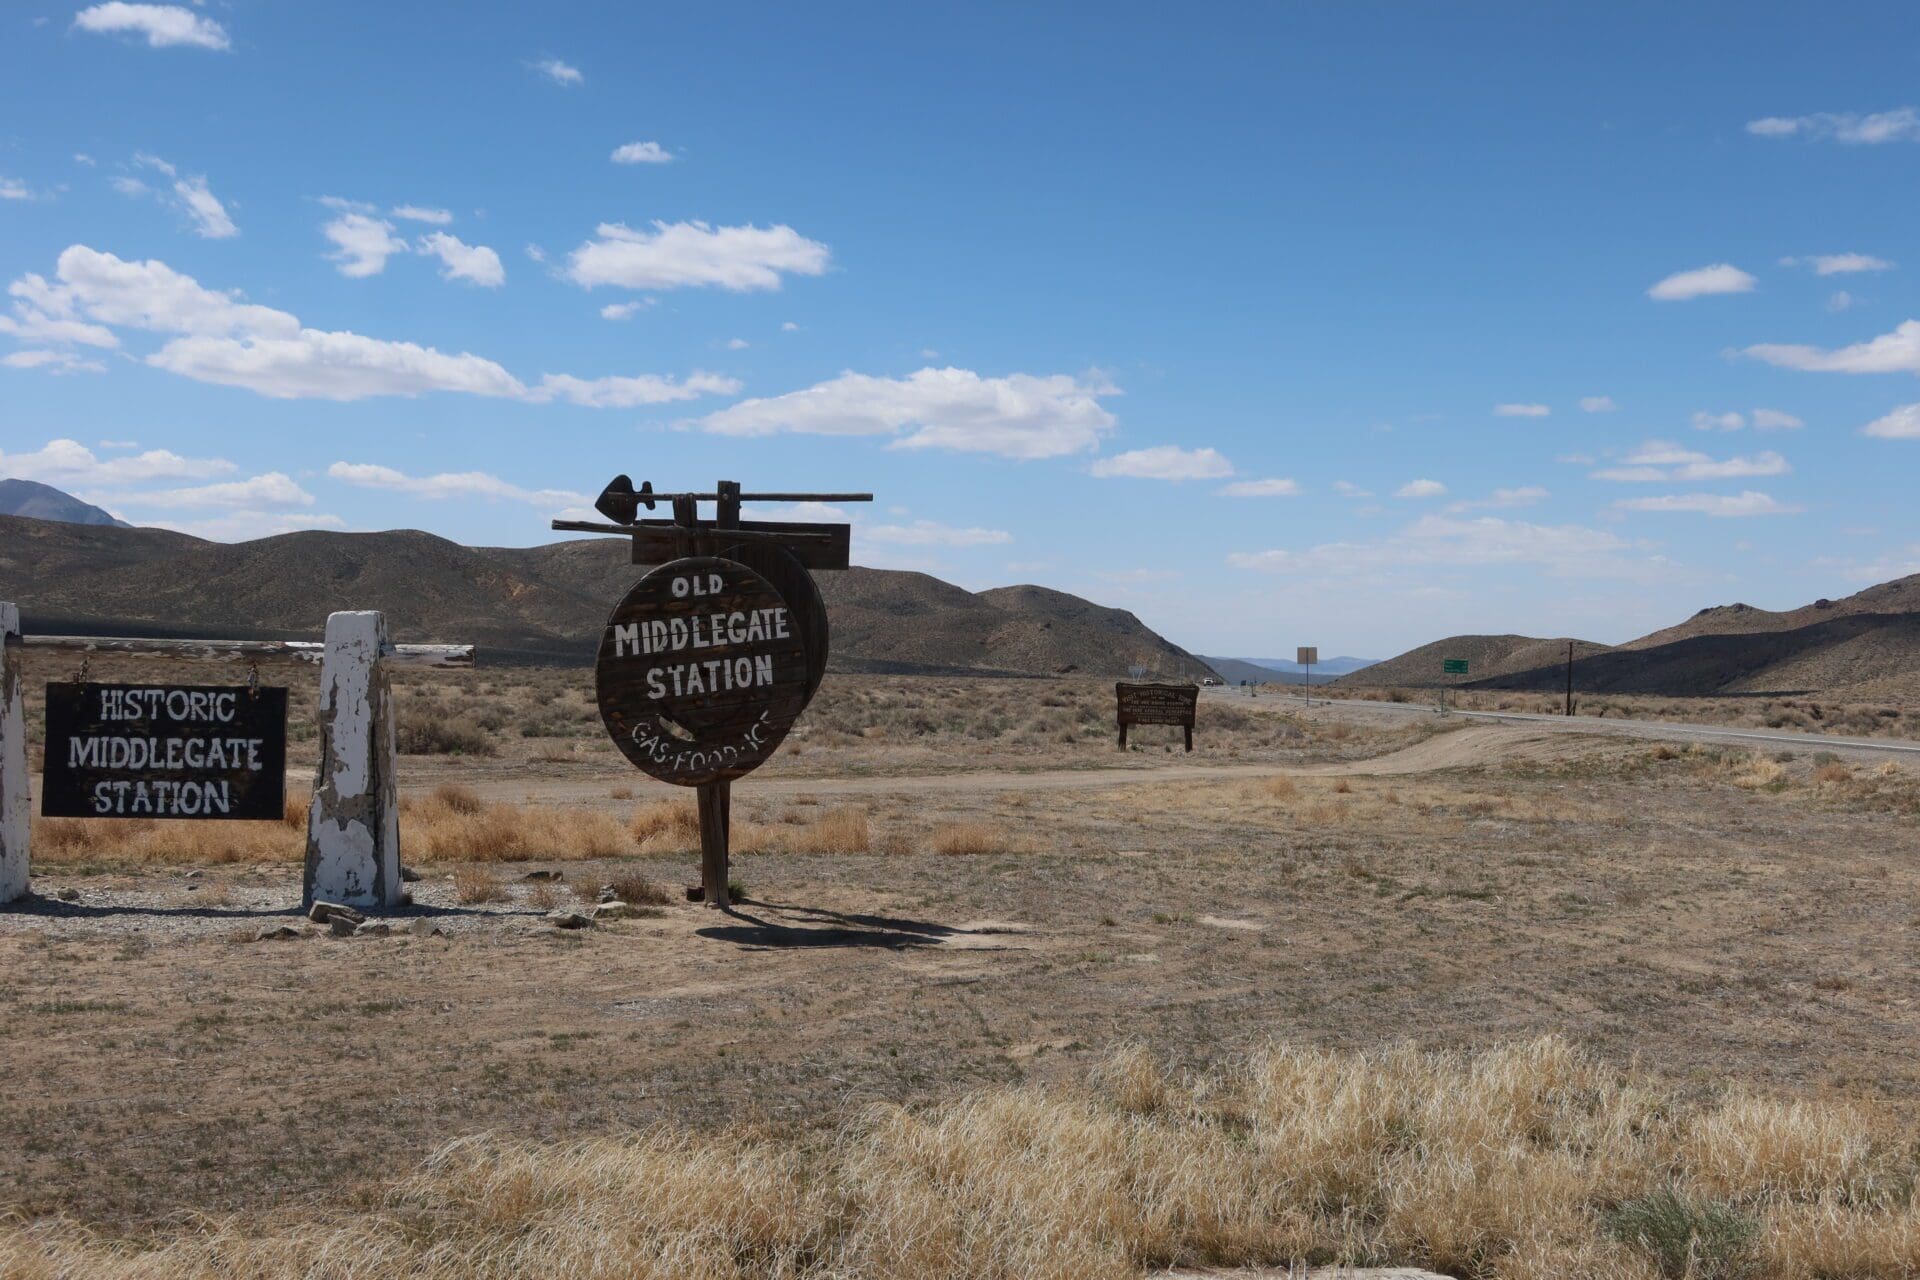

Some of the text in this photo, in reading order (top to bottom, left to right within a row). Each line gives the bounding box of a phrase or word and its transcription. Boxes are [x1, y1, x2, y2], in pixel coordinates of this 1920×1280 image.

[671, 574, 723, 598] OLD
[614, 607, 790, 657] MIDDLEGATE
[646, 654, 773, 700] STATION
[100, 689, 236, 722] HISTORIC
[67, 736, 264, 771] MIDDLEGATE
[94, 780, 230, 815] STATION
